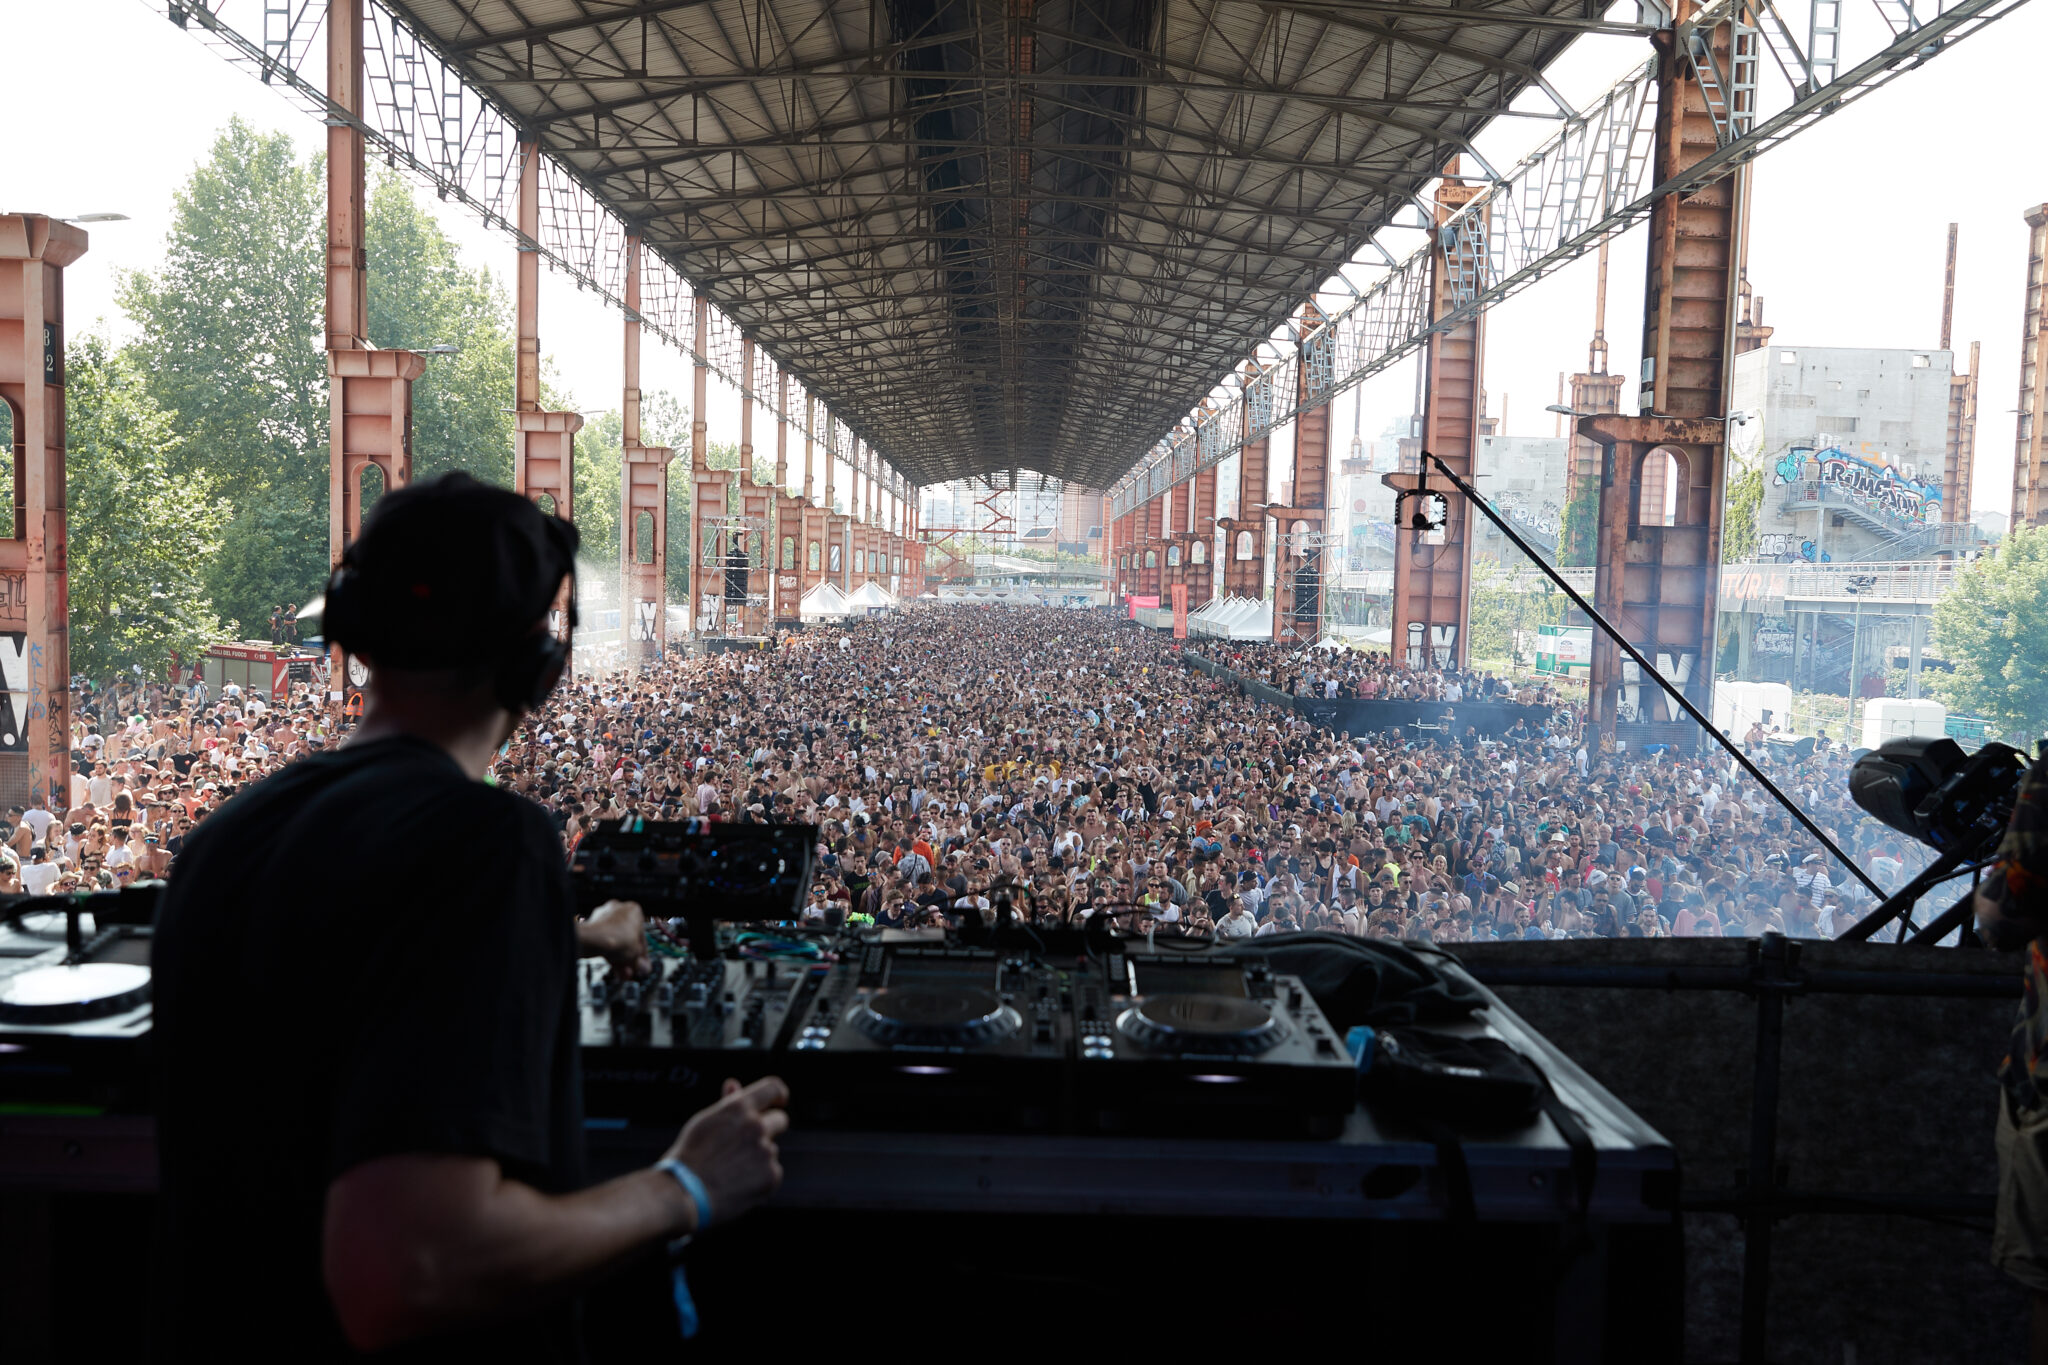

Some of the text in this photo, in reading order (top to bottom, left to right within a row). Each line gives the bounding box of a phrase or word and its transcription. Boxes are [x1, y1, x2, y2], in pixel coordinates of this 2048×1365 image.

[43, 328, 51, 347] B
[46, 354, 54, 372] 2
[232, 650, 248, 658] FUOCO
